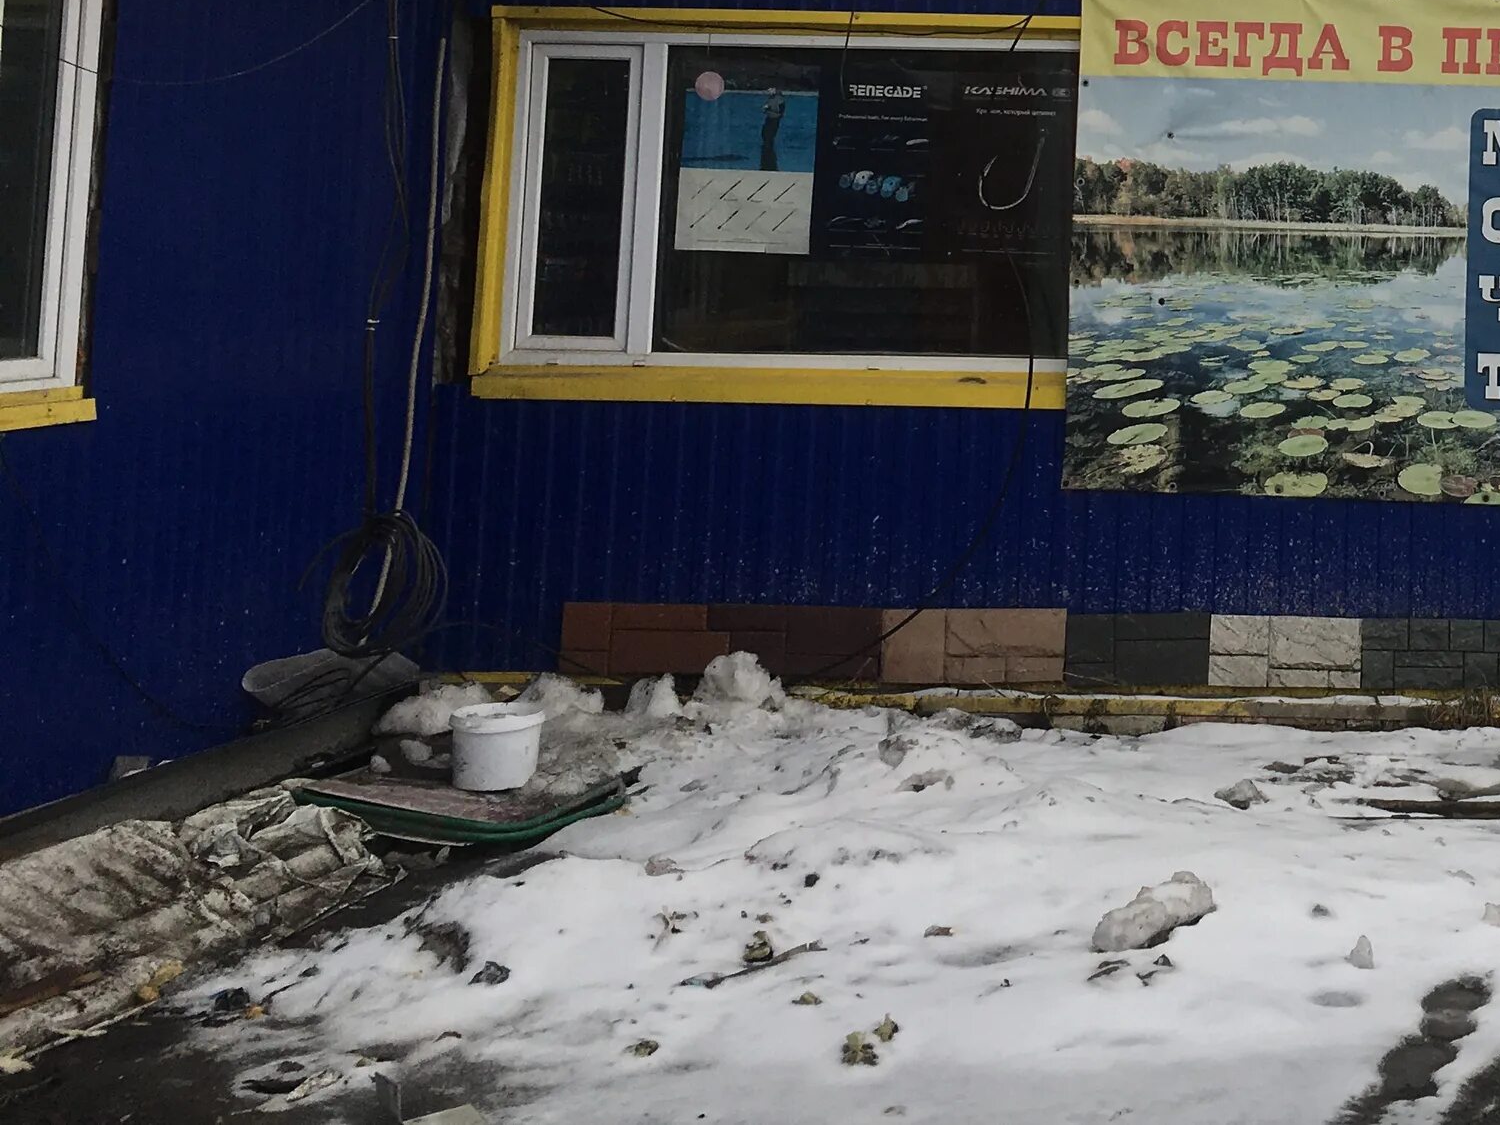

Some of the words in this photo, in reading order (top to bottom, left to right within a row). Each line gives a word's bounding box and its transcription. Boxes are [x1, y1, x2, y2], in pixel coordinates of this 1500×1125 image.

[1113, 18, 1351, 78] ВСЕГДА
[1377, 25, 1414, 73] В
[849, 84, 922, 99] RENEGADE
